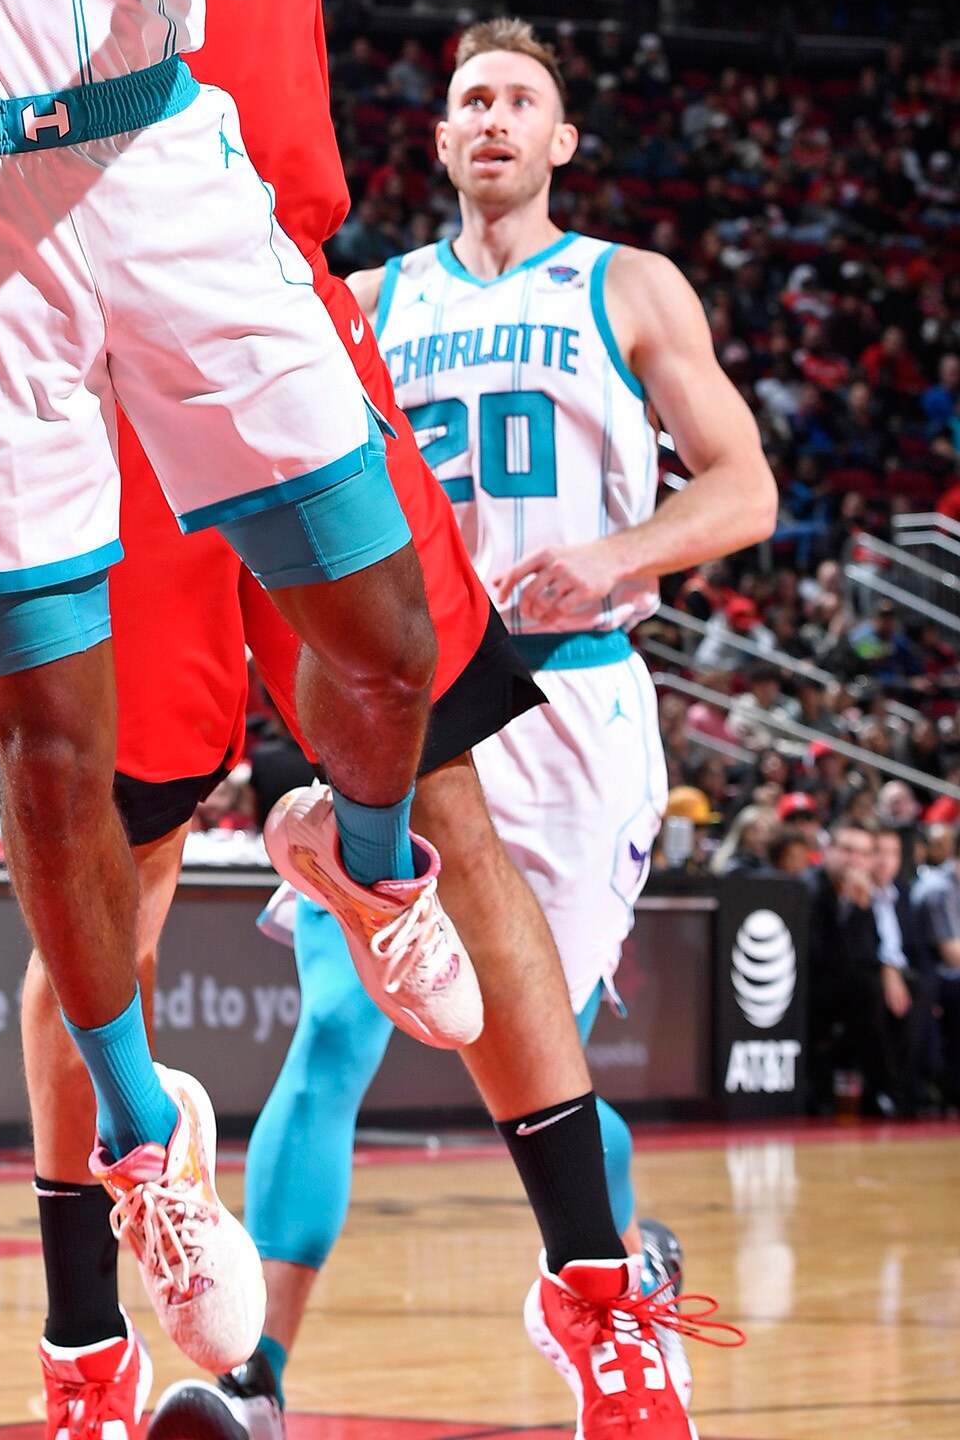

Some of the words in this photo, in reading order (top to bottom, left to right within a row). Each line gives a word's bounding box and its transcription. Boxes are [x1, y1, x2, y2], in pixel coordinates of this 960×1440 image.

[385, 323, 580, 389] CHARLOTTE
[403, 390, 558, 505] 20
[200, 975, 246, 1028] to
[724, 1039, 802, 1093] AT&T
